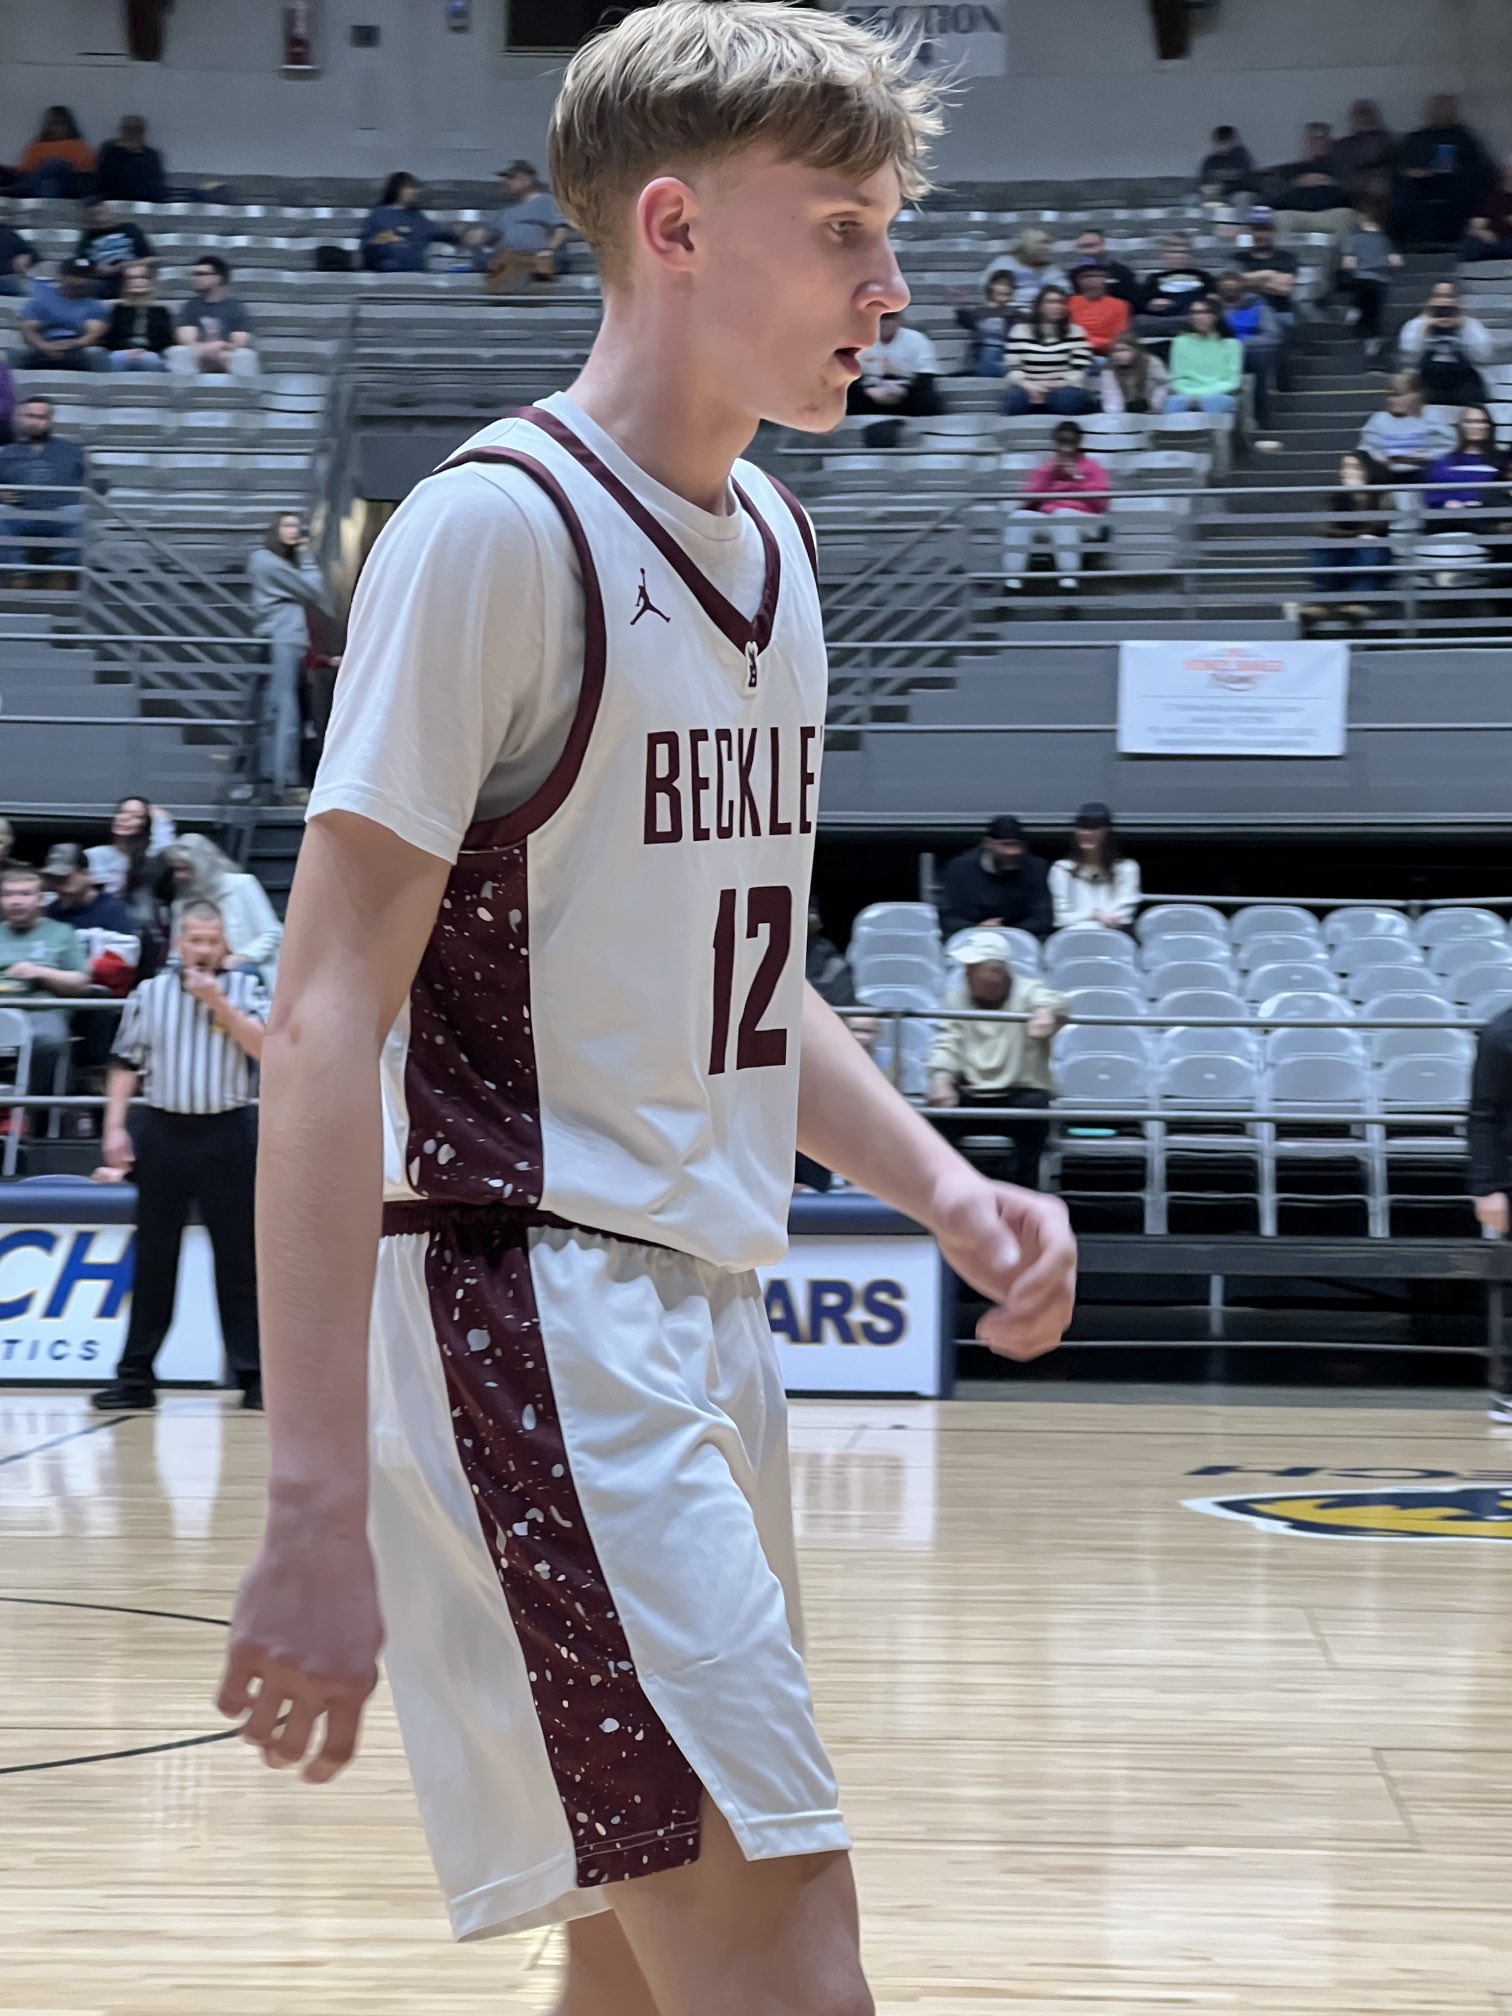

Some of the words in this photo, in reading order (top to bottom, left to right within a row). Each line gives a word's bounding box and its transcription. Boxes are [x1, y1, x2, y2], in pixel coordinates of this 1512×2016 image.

[644, 725, 823, 844] BECKLE
[708, 886, 792, 1075] 12
[1, 1339, 100, 1361] TICS
